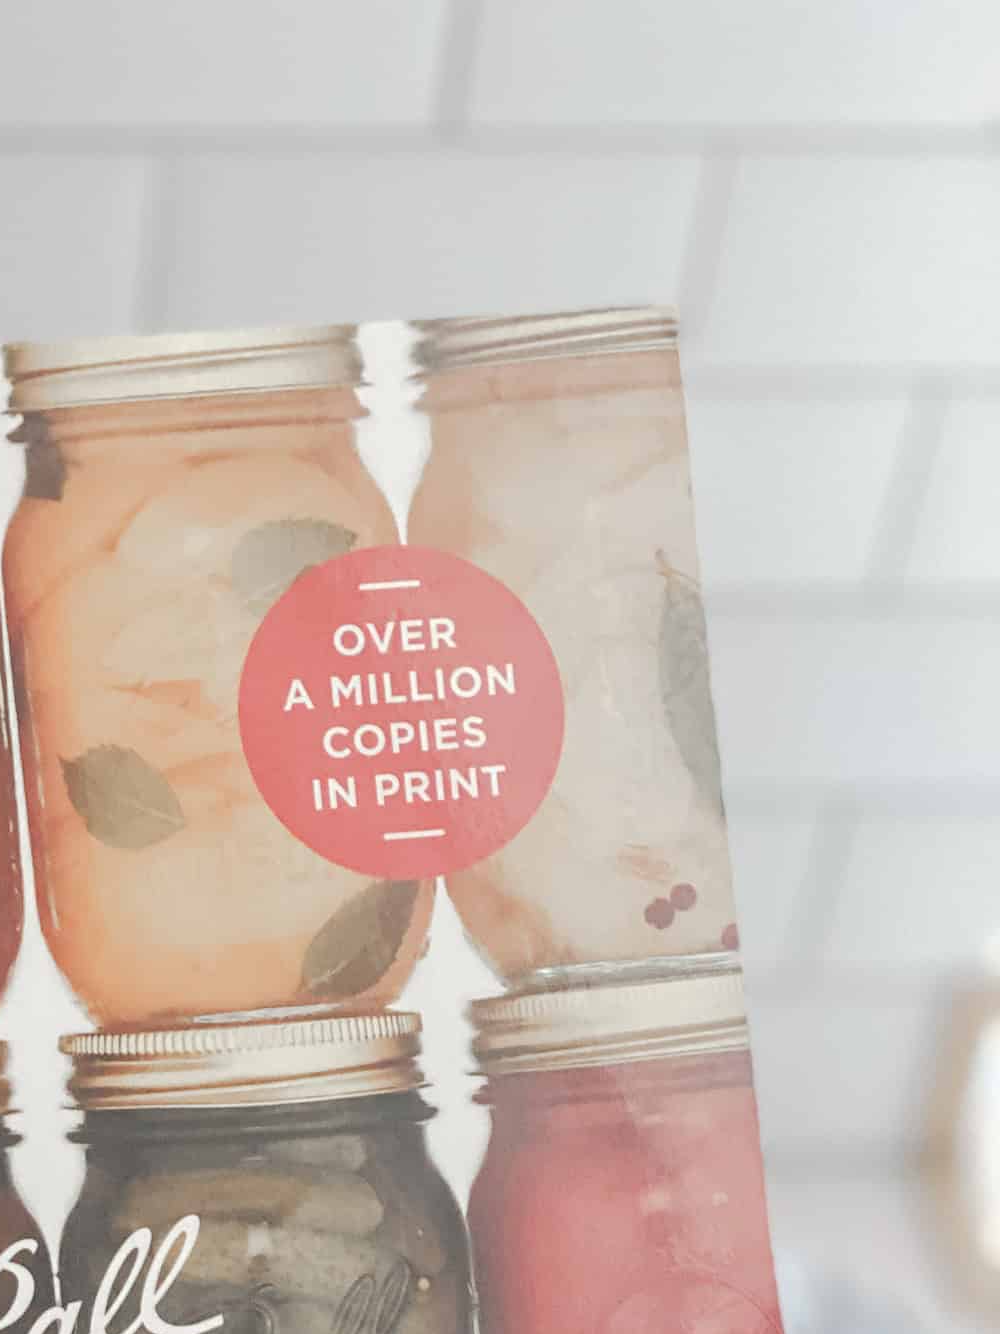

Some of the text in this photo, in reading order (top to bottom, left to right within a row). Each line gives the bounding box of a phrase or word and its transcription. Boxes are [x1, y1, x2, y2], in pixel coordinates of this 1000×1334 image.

[333, 618, 457, 656] OVER
[283, 663, 516, 711] A MILLION
[322, 716, 487, 759] COPIES
[311, 765, 506, 811] IN PRINT
